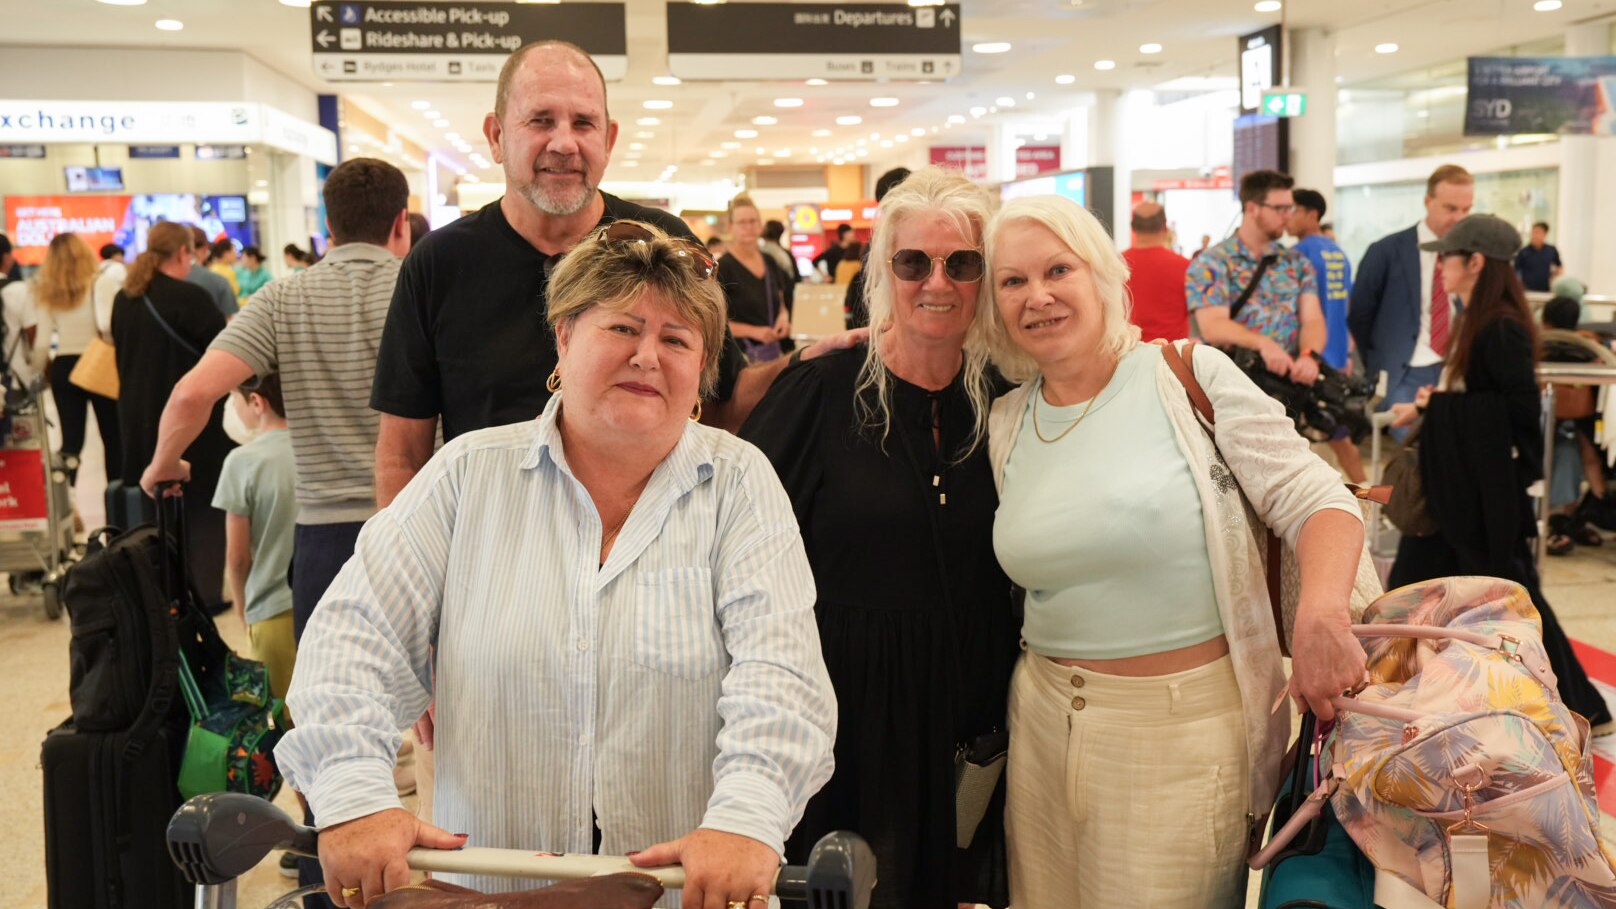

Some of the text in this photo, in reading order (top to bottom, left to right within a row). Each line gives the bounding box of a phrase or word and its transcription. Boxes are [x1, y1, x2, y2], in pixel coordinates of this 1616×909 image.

[364, 6, 510, 27] Accessible Pick-up
[833, 9, 913, 28] Departures
[365, 30, 522, 50] Rideshare & Pick-up
[363, 60, 437, 74] Rydges Hotel
[467, 60, 497, 72] Taxis
[826, 60, 856, 72] Buses
[885, 60, 917, 72] Trains
[1472, 98, 1512, 118] SYD
[0, 110, 136, 134] xchange
[16, 217, 115, 233] AUSTRALIAN
